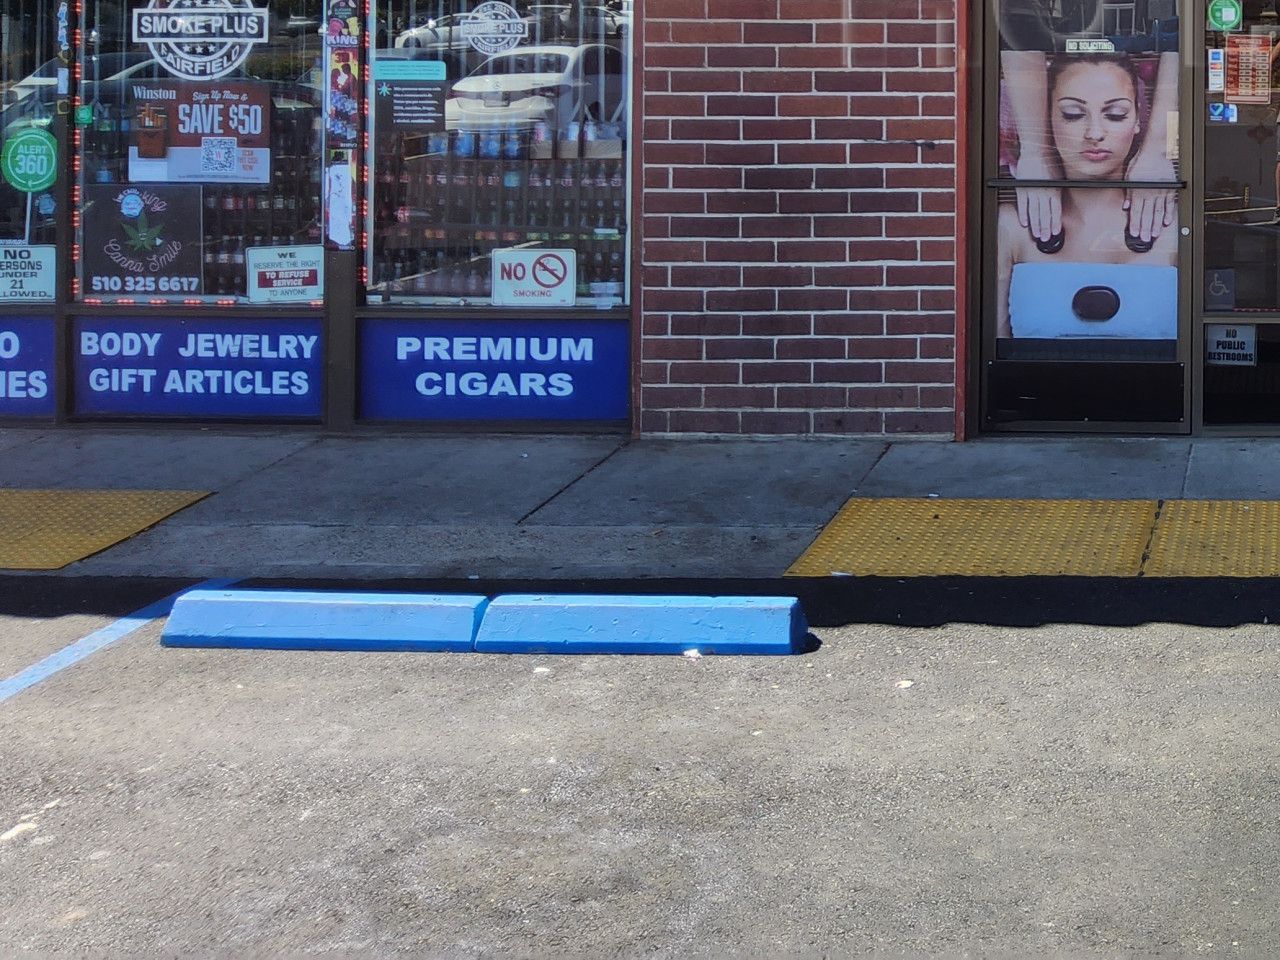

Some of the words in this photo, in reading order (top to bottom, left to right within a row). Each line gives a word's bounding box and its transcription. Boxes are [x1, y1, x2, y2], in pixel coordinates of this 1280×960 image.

[140, 15, 205, 34] SMOKE
[211, 15, 259, 34] PLUS
[161, 42, 240, 74] FAIRFIELD
[133, 85, 177, 100] Winston
[178, 103, 224, 134] SAVE
[17, 144, 48, 154] ALERT
[15, 154, 48, 175] 360
[4, 249, 31, 260] NO
[103, 238, 144, 273] Canna
[146, 240, 182, 272] Smile
[265, 271, 277, 279] TO
[278, 270, 310, 279] REFUSE
[500, 262, 526, 281] NO
[10, 279, 24, 289] 21
[92, 276, 122, 291] 510
[124, 276, 156, 291] 325
[158, 276, 199, 291] 6617
[272, 279, 303, 287] SERVICE
[0, 290, 47, 298] LOWED
[512, 289, 552, 298] SMOKING
[1226, 329, 1237, 338] NO
[80, 331, 162, 357] BODY
[178, 333, 318, 359] JEWELRY
[396, 336, 594, 362] PREMIUM
[1216, 340, 1246, 350] PUBLIC
[1208, 351, 1254, 361] RESTROOMS
[88, 368, 157, 393] GIFT
[163, 370, 310, 395] ARTICLES
[415, 371, 575, 397] CIGARS
